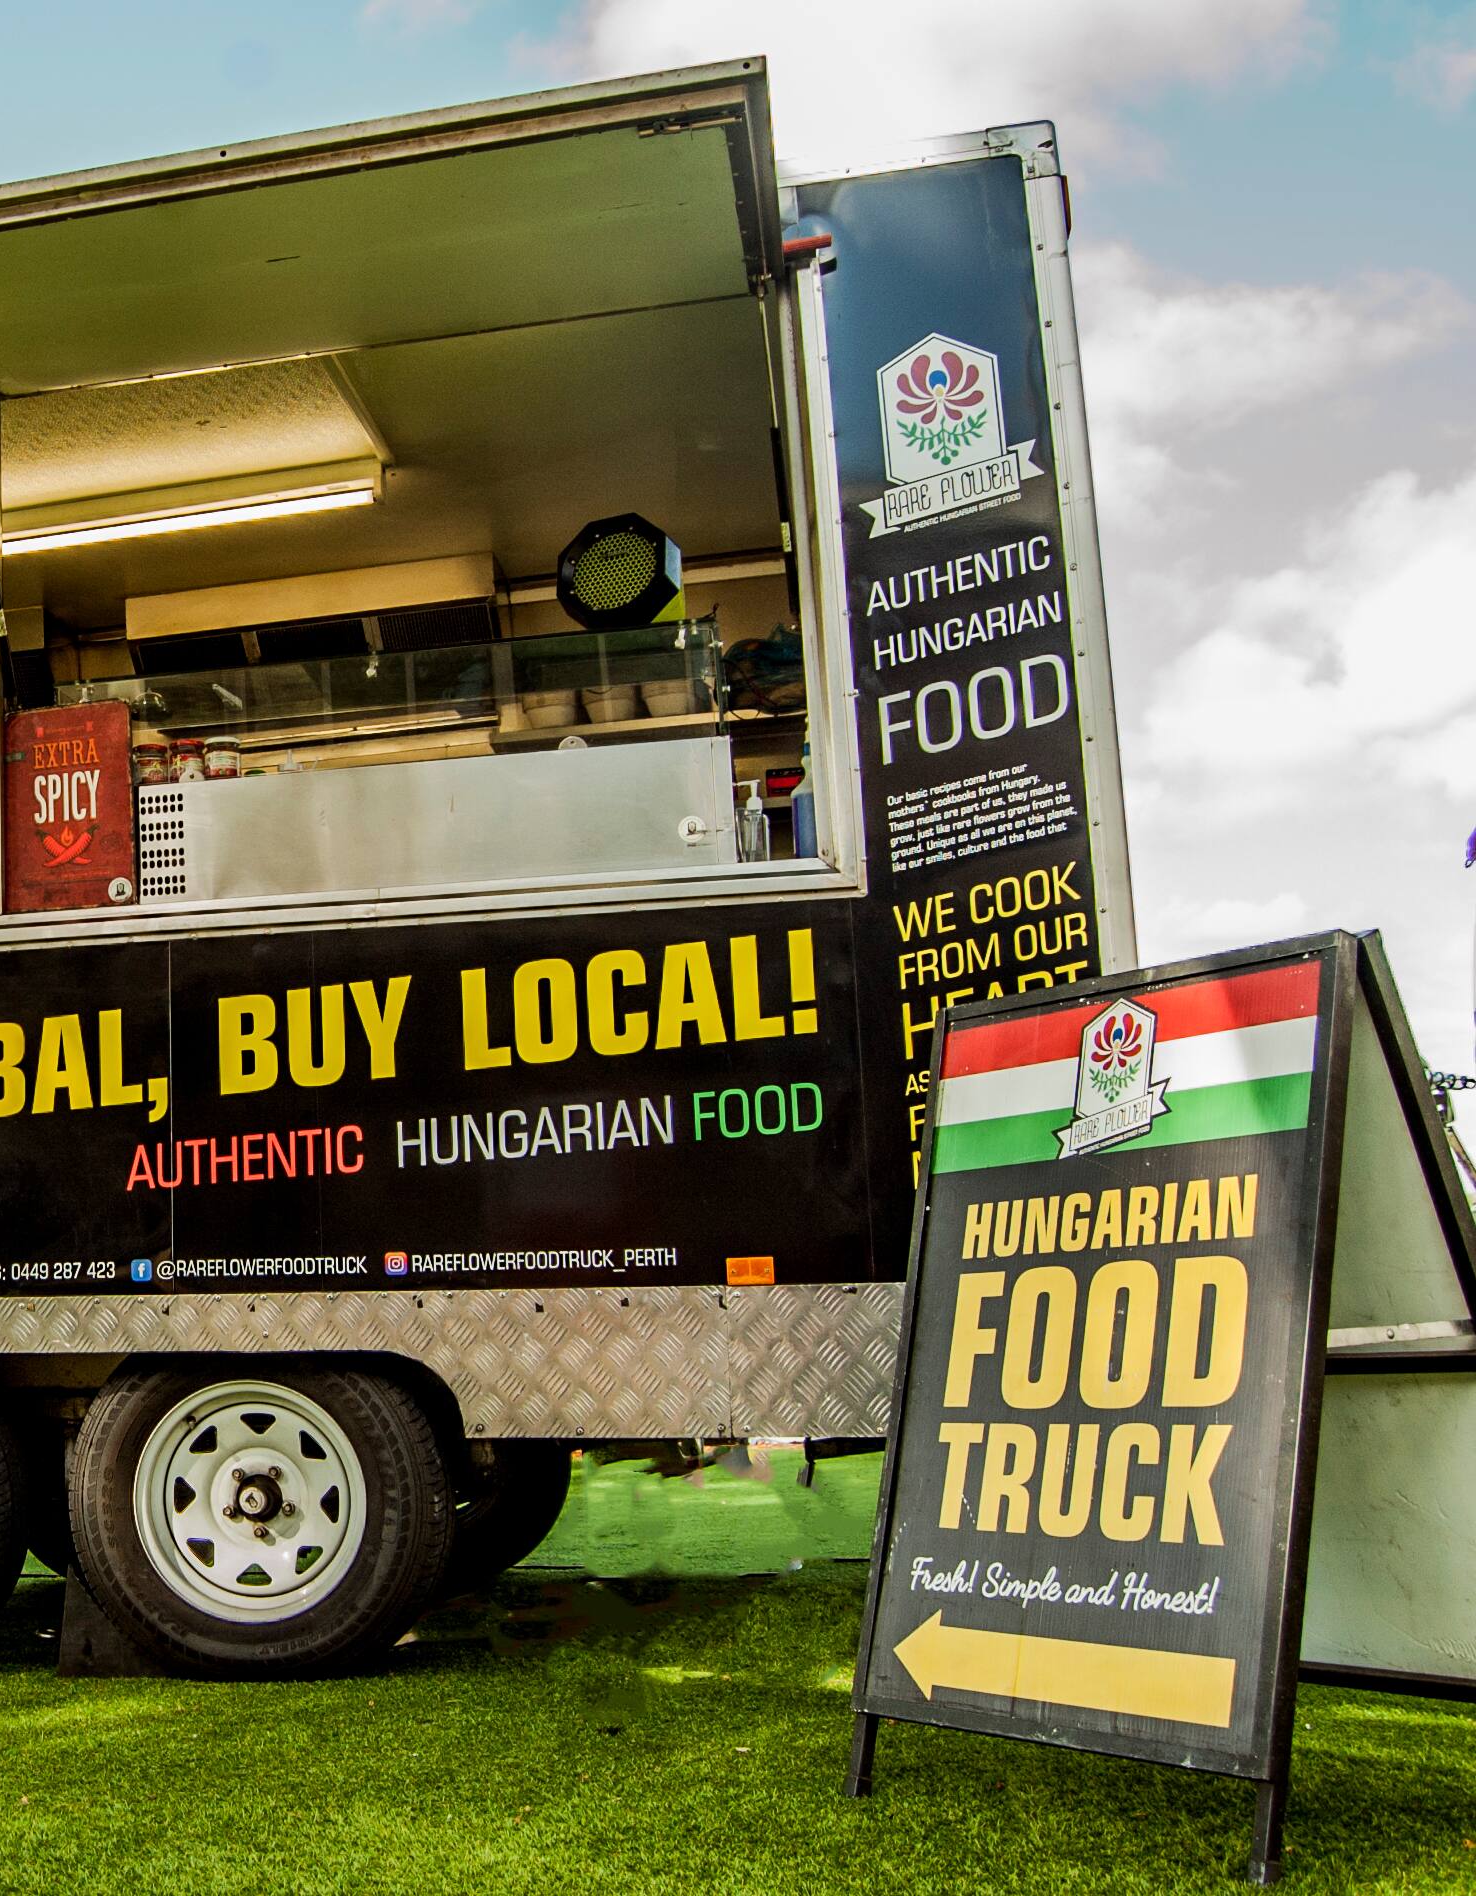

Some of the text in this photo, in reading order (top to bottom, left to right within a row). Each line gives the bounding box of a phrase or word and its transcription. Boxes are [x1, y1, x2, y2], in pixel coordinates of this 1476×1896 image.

[887, 460, 1014, 520] RARE FLOWER
[867, 536, 1050, 616] AUTHENTIC
[874, 591, 1062, 670] HUNGARIAN
[879, 654, 1068, 765] FOOD
[33, 738, 100, 769] EXTRA
[34, 770, 100, 824] SPICY
[887, 795, 903, 807] Our
[906, 788, 928, 802] basic
[930, 781, 961, 796] recipes
[989, 769, 1009, 782] from
[889, 819, 914, 833] These
[1008, 791, 1027, 804] they
[932, 788, 976, 808] cookbooks
[979, 784, 999, 797] from
[1002, 774, 1040, 791] Hungary.
[974, 810, 1005, 825] flowers
[1033, 799, 1053, 811] from
[958, 842, 988, 857] culture
[893, 861, 1081, 942] WE COOK
[899, 912, 1087, 989] FROM OUR
[219, 975, 412, 1095] BUY
[461, 928, 818, 1071] LOCAL!
[127, 1082, 823, 1191] AUTHENTIC HUNGARIAN FOOD
[962, 1173, 1258, 1260] HUNGARIAN
[12, 1263, 48, 1280] 0449
[53, 1262, 81, 1279] 287
[87, 1261, 116, 1278] 423
[156, 1256, 367, 1280] @RAREFLOWERFOODTRUCK
[412, 1248, 676, 1272] RAREFLOWERFOODTRUCK_PERTH
[943, 1255, 1250, 1409] FOOD
[938, 1422, 1233, 1546] TRUCK
[911, 1556, 1219, 1614] Fresh! Simple and Honest!
